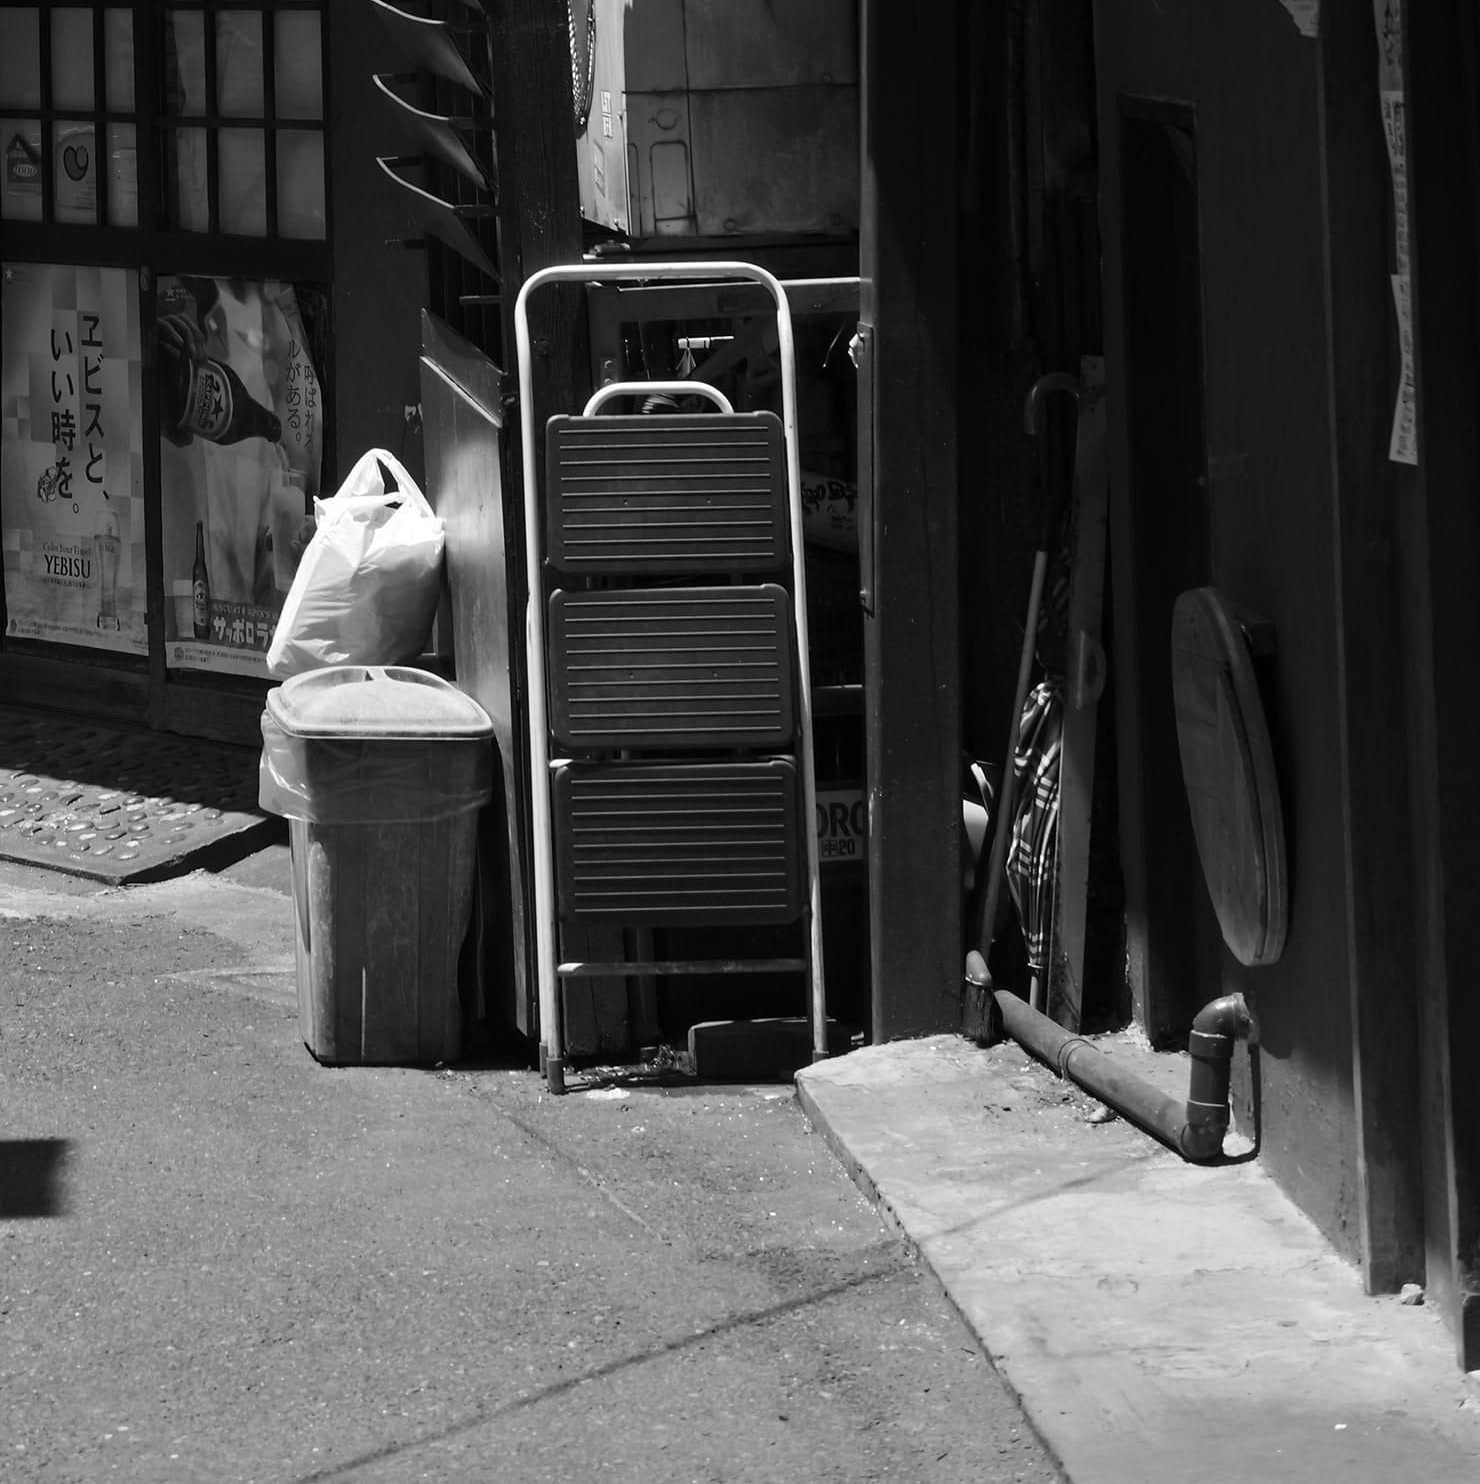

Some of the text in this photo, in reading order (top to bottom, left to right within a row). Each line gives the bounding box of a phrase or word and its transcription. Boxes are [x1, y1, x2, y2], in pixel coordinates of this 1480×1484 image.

[51, 329, 80, 514] いい時を。
[44, 554, 91, 579] YEBISU
[839, 839, 855, 855] 20
